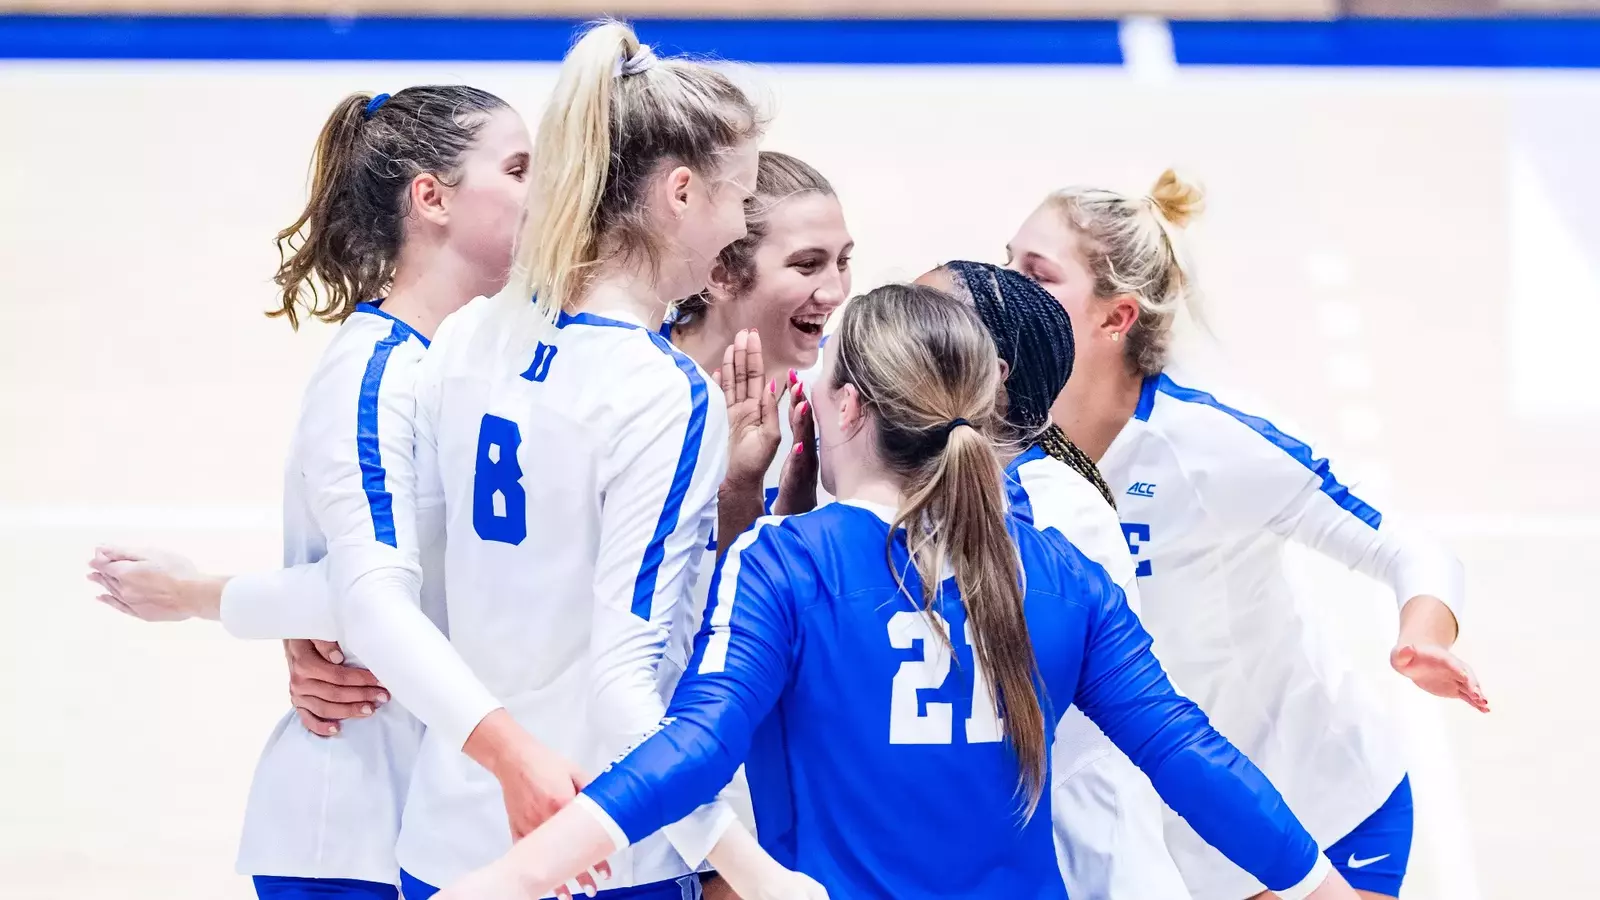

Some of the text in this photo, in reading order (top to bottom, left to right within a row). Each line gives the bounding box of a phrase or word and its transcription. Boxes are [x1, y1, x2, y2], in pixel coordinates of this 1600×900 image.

[472, 412, 527, 546] 8
[1126, 481, 1157, 498] ACC
[886, 610, 1004, 745] 21
